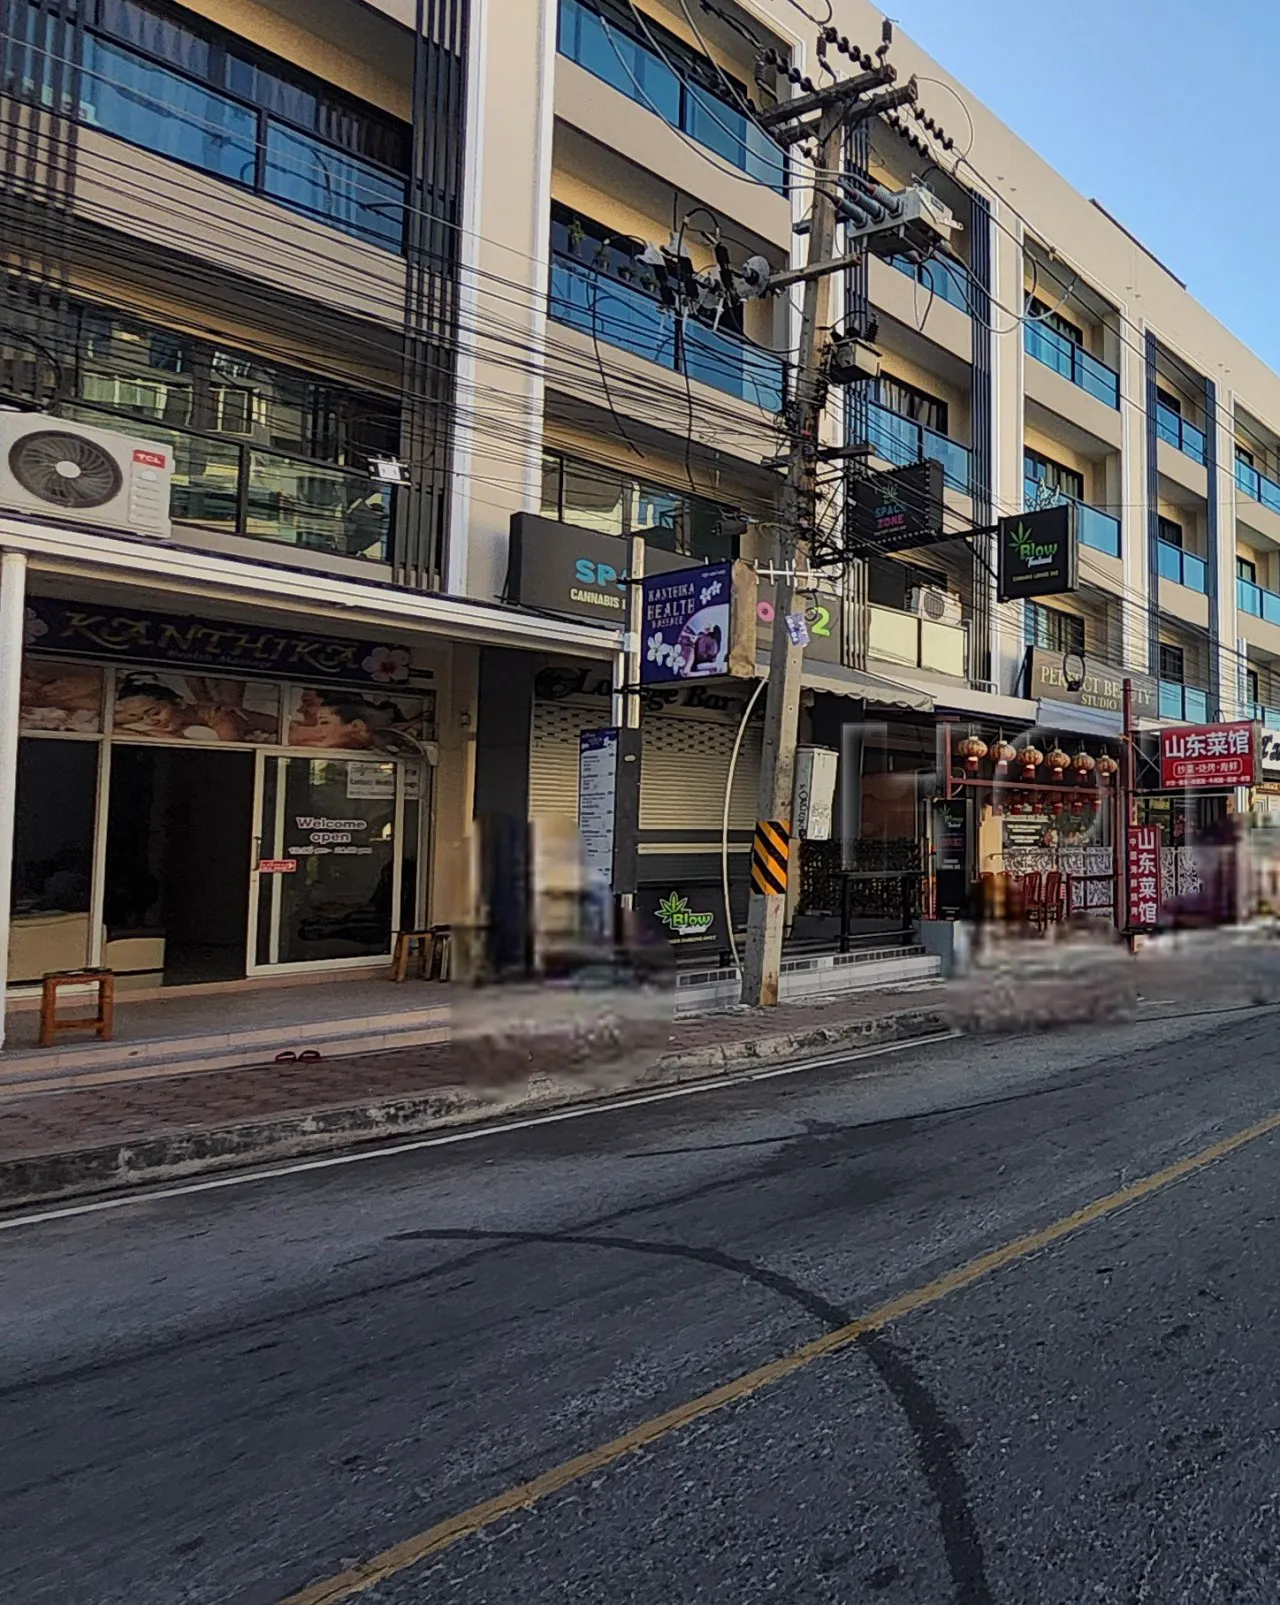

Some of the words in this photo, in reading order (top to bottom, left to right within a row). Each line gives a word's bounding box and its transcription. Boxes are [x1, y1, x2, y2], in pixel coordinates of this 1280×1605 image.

[136, 453, 163, 464] TCL
[1020, 542, 1058, 559] Blow
[570, 588, 620, 608] CANNABIS
[58, 610, 360, 673] KANTHIKA
[573, 668, 679, 712] Loge
[1104, 680, 1152, 706] BETY
[1081, 694, 1117, 710] STUDIO
[1165, 729, 1249, 758] 山东菜馆
[296, 817, 367, 830] Welcome
[310, 831, 351, 844] open
[1138, 828, 1157, 923] 山东菜馆
[672, 913, 711, 927] Blow
